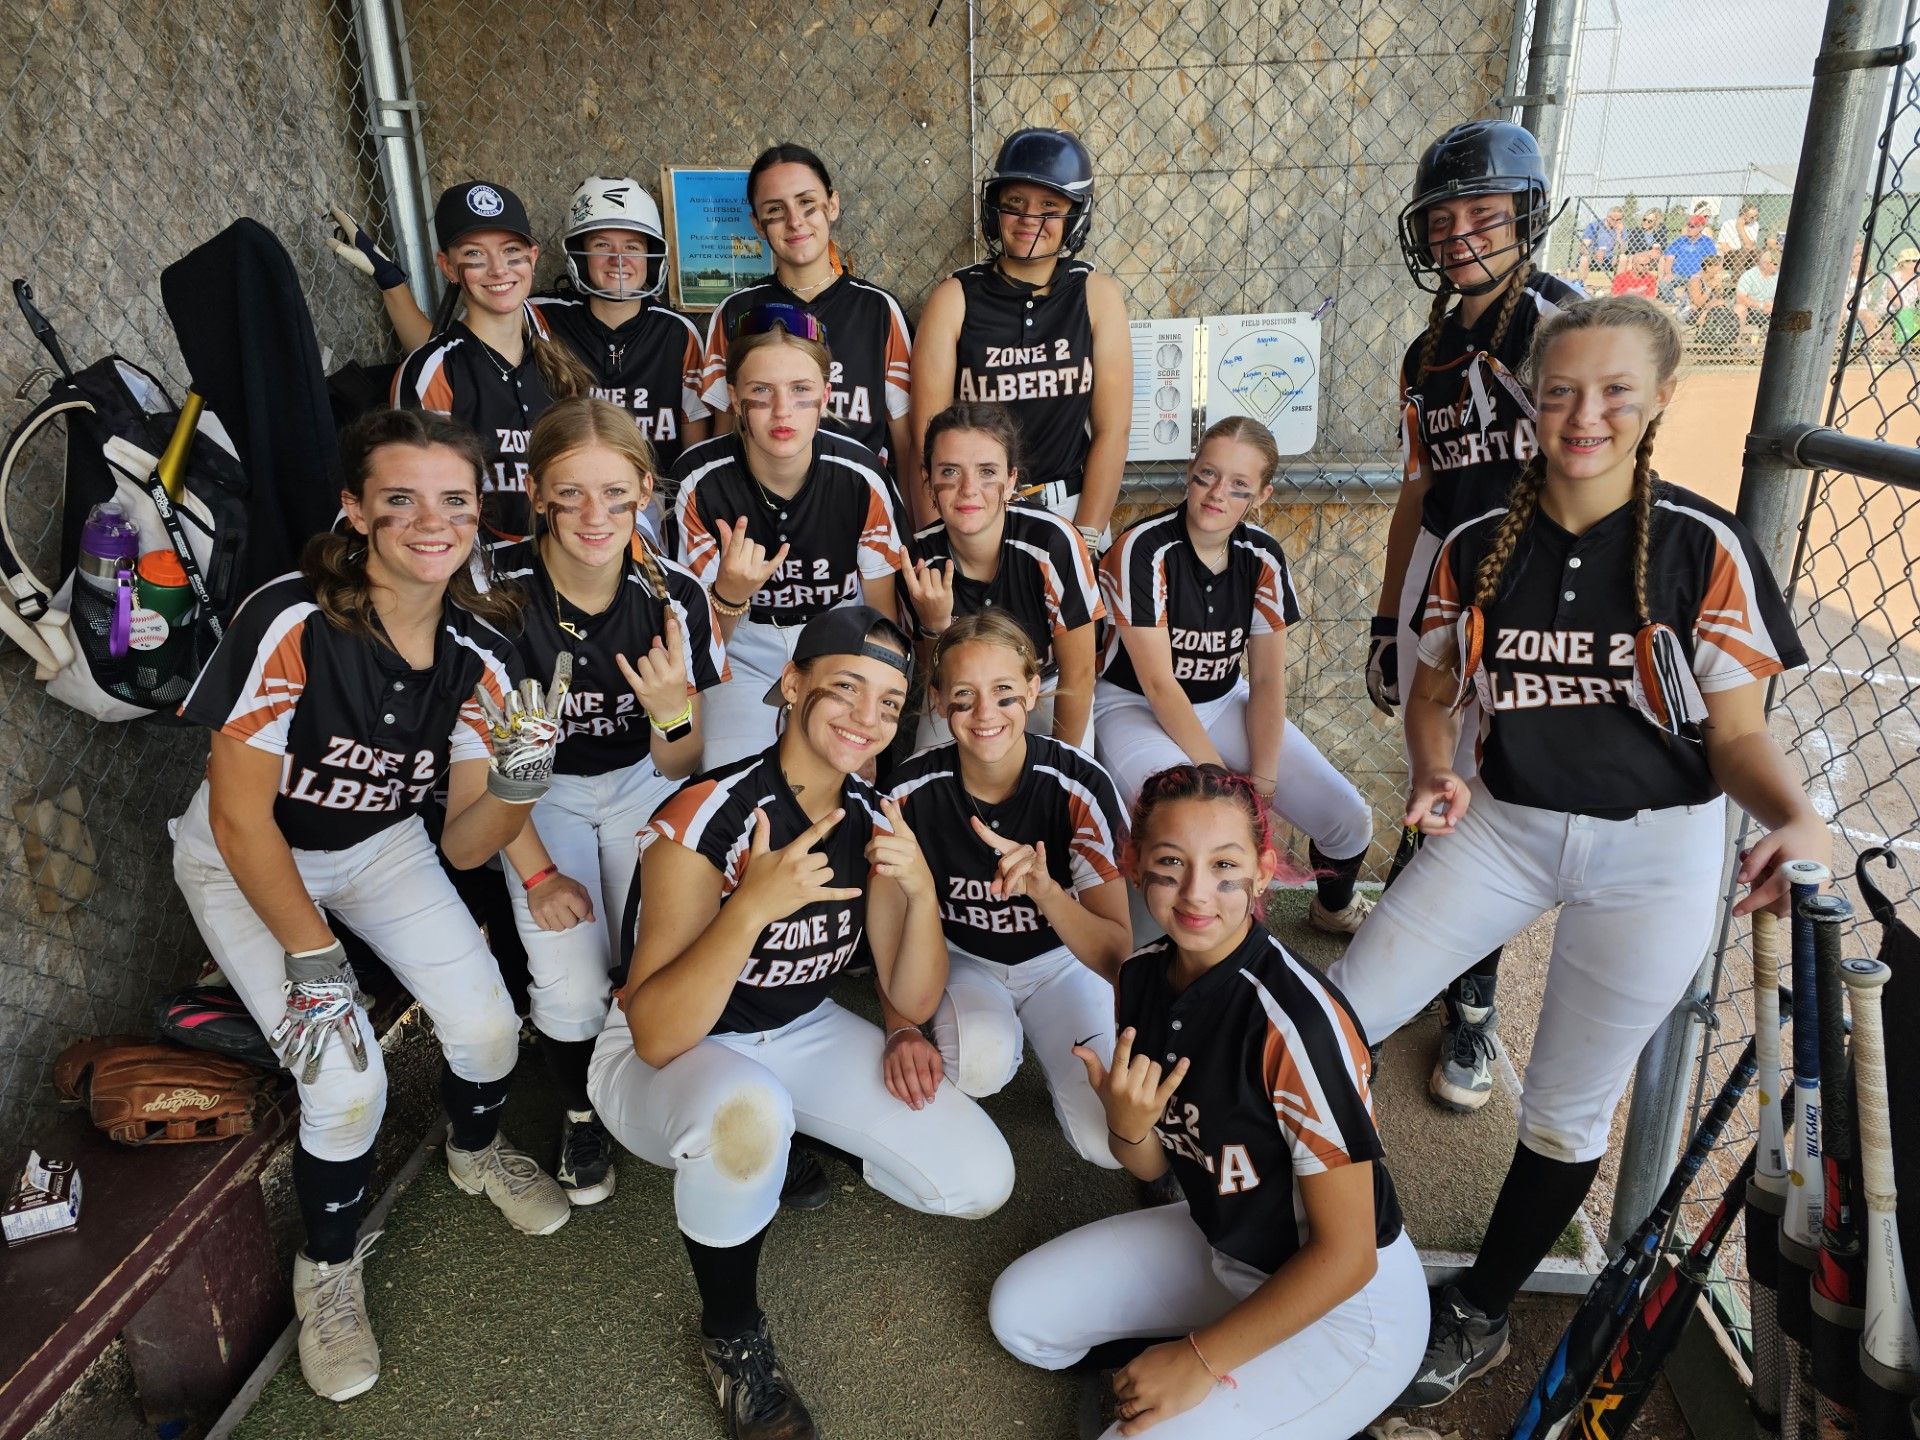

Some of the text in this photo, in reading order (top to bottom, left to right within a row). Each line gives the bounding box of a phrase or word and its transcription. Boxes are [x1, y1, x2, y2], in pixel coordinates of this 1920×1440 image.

[1241, 317, 1297, 327] FIELD POSITIONS
[828, 361, 844, 384] 2
[985, 338, 1071, 368] ZONE 2
[634, 387, 649, 409] 2
[959, 356, 1094, 402] ALBERTA
[1291, 404, 1313, 412] SPARES
[751, 570, 860, 609] BERTA
[771, 558, 831, 583] NE 2
[1171, 626, 1244, 654] ZONE 2
[1495, 628, 1636, 667] ZONE 2
[1174, 639, 1248, 681] BERT
[563, 691, 635, 718] NE 2
[1490, 670, 1636, 711] LBERT
[320, 735, 436, 780] ZONE 2
[278, 752, 441, 813] LBERT
[762, 908, 851, 951] ZONE 2
[737, 926, 863, 988] LBERT
[142, 1092, 220, 1113] Rawlings
[1806, 1103, 1819, 1158] CRYSTAL
[1880, 1218, 1895, 1268] GHOST
